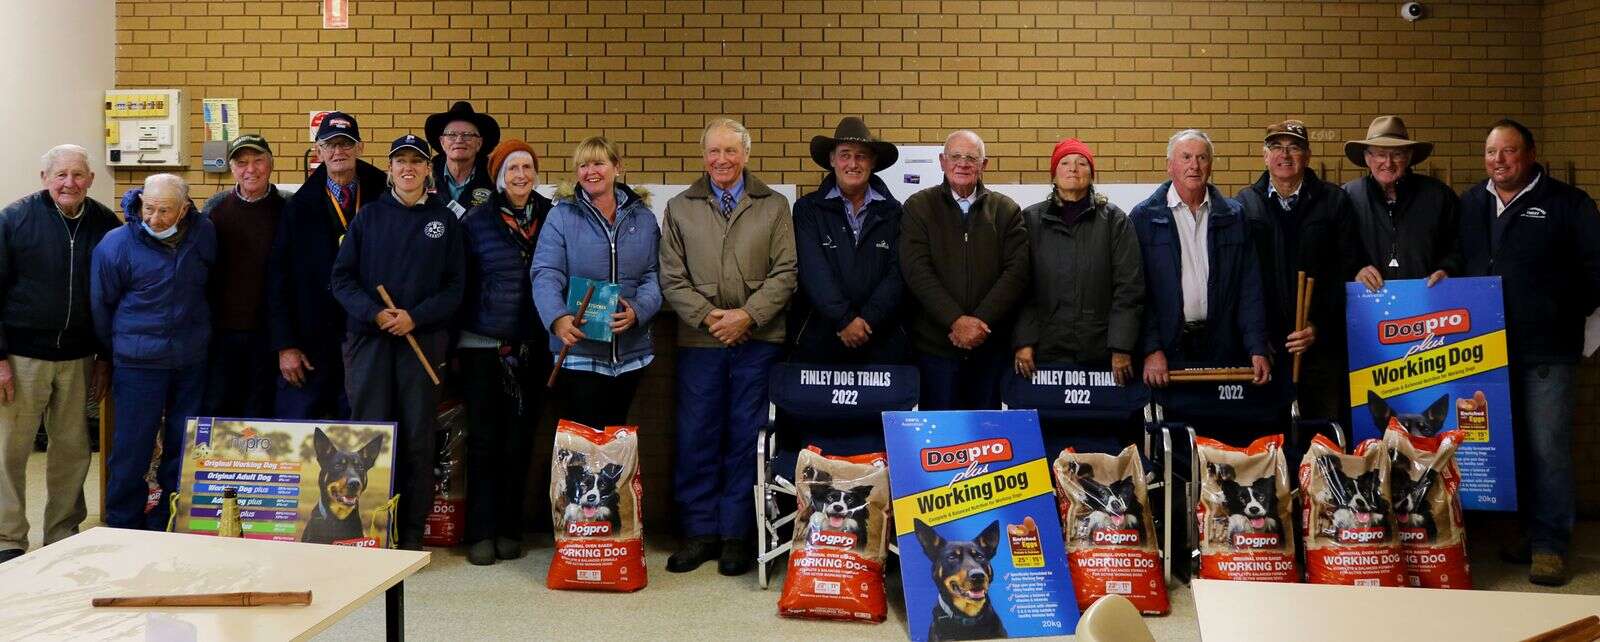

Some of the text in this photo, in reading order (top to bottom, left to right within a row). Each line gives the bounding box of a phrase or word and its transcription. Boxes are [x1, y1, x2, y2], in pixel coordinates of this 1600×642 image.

[1384, 313, 1462, 338] Dogpro
[1404, 334, 1445, 360] plus
[1372, 344, 1484, 387] Working Dog
[800, 370, 891, 387] FINLEY DOG TRIALS
[1032, 370, 1120, 387] FINLEY DOG TRIAL
[832, 389, 858, 405] 2022
[1065, 389, 1090, 404] 2022
[1218, 385, 1244, 400] 2022
[928, 443, 1004, 466] Dogpro
[204, 460, 231, 469] Original
[233, 461, 261, 469] Working
[263, 462, 278, 470] Dog
[208, 471, 235, 480] Original
[236, 472, 255, 480] Adult
[257, 474, 272, 482] Dog
[948, 461, 989, 487] plus
[238, 486, 253, 494] Dog
[917, 472, 1029, 514] Working Dog
[569, 524, 609, 536] Dogpro
[811, 532, 854, 546] Dogpro
[1096, 532, 1137, 544] Dogpro
[1236, 535, 1277, 547] Dogpro
[1342, 531, 1384, 543] Dogpro
[1400, 532, 1424, 541] gpro
[604, 548, 628, 557] DOG
[1421, 554, 1446, 563] DOG
[794, 558, 842, 568] WORKING
[1078, 558, 1154, 568] WORKING DOG
[1324, 556, 1378, 565] WORKING
[1382, 554, 1400, 564] DOG
[1218, 562, 1293, 571] WORKING DOG
